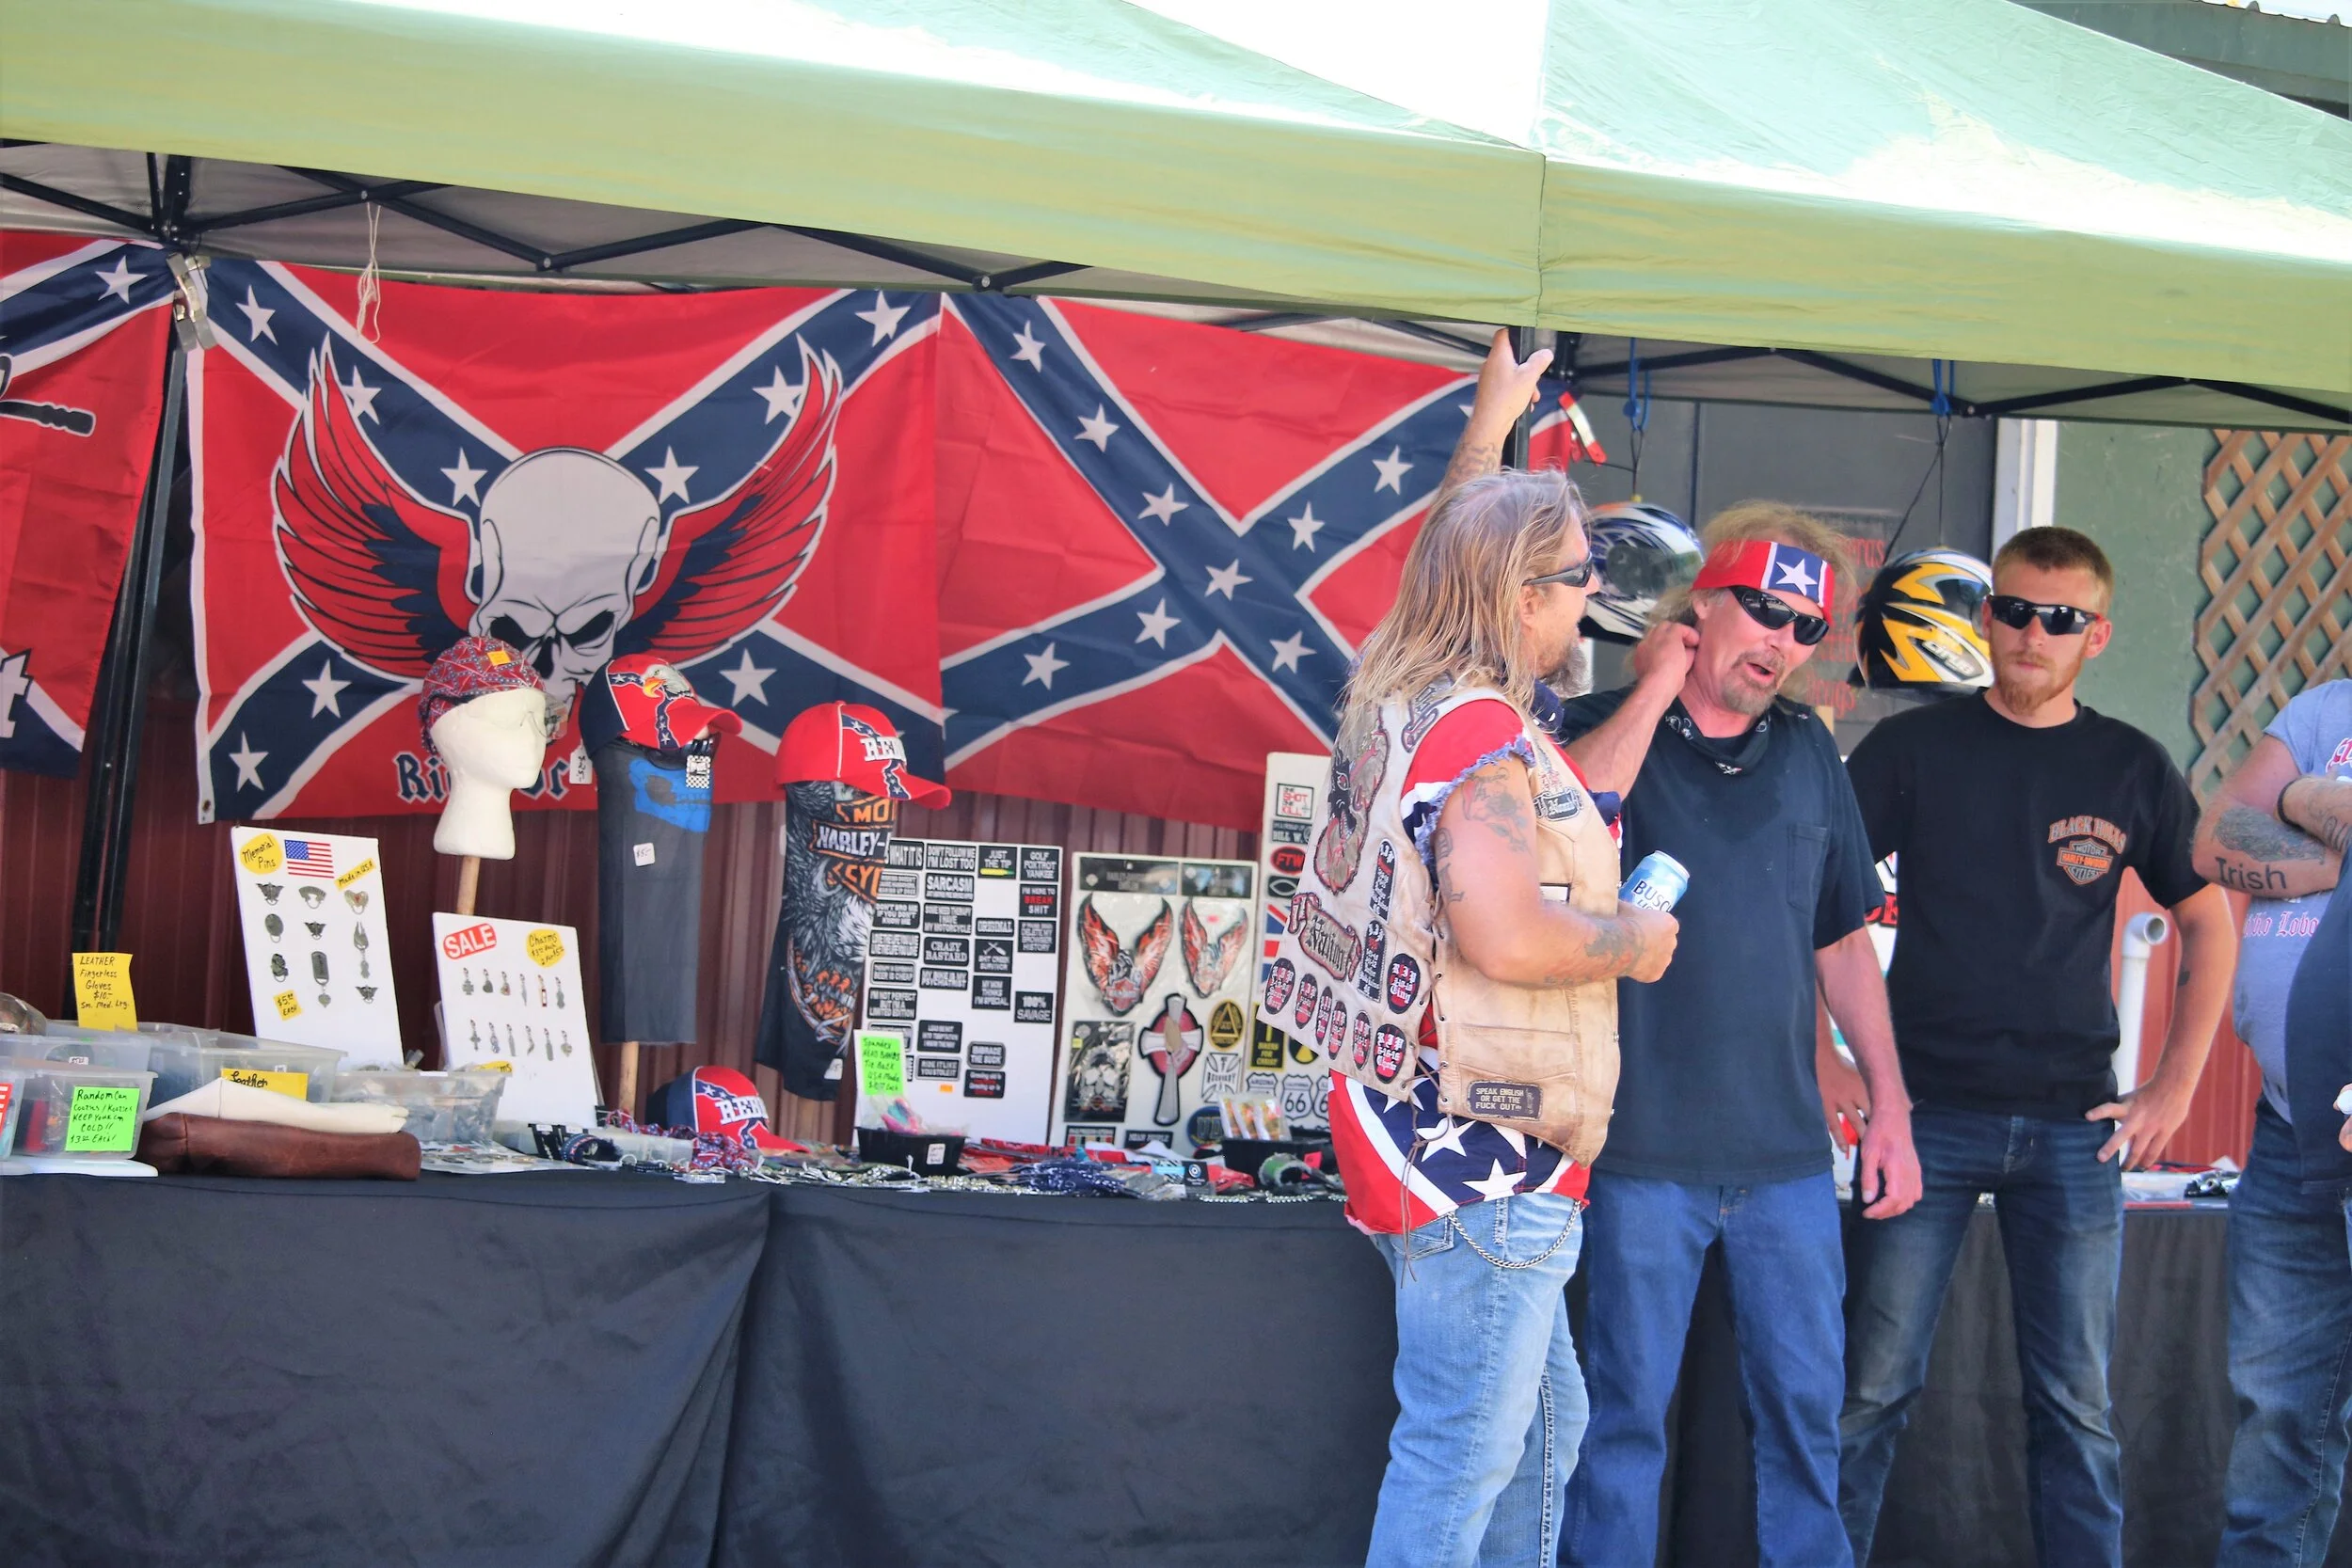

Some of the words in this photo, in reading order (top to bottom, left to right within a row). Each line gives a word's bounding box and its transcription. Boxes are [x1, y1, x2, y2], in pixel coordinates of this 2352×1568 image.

[2048, 816, 2093, 843] BLACK
[989, 850, 1008, 859] JUST
[1030, 851, 1050, 861] GOLF
[258, 857, 276, 869] Pins
[940, 857, 959, 868] LOST
[960, 858, 975, 869] TOO
[1276, 853, 1304, 869] FTW
[2215, 856, 2286, 890] Irish
[927, 876, 973, 893] SARCASM
[1028, 905, 1049, 914] SHIT
[444, 924, 496, 958] SALE
[529, 933, 557, 947] Charms
[930, 941, 961, 952] CRAZY
[80, 956, 115, 966] LEATHER
[926, 950, 968, 962] BASTARD
[80, 969, 118, 979] Fingerless
[86, 980, 112, 990] Gloves
[1017, 1008, 1051, 1021] SAVAGE
[77, 1089, 113, 1101] Random
[1285, 1092, 1306, 1112] 66
